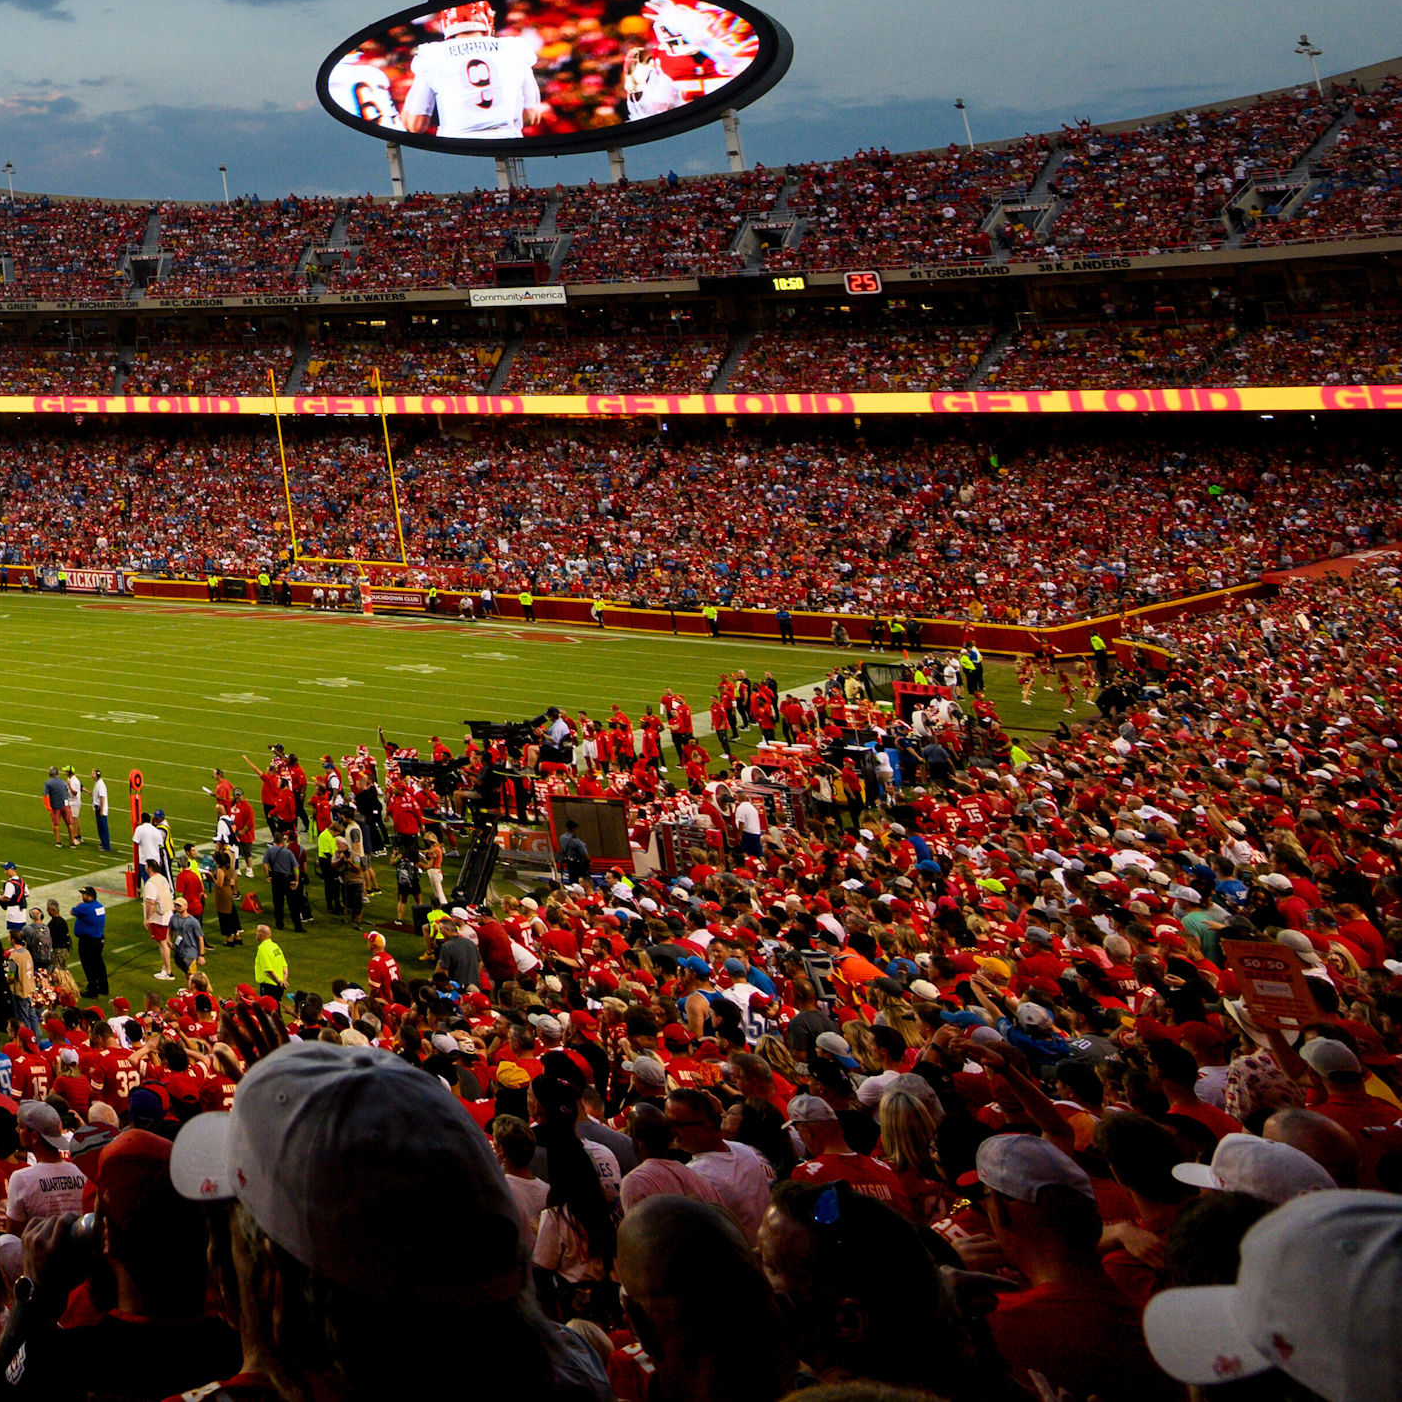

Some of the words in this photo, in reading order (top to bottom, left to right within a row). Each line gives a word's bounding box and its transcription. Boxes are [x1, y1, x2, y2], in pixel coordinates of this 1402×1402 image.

[466, 59, 491, 109] 9
[910, 270, 923, 279] 61
[925, 269, 935, 278] T.
[937, 265, 1010, 278] GRUNHARD
[1038, 263, 1053, 272] 38
[1055, 262, 1069, 271] K.
[1072, 258, 1132, 271] ANDERS
[772, 276, 805, 291] 10:50
[850, 274, 877, 291] 25
[78, 301, 139, 309] RICHARDSON
[265, 296, 320, 304] GONZALEZ
[362, 293, 406, 302] WATERS
[472, 290, 564, 304] CommunityAmerica
[33, 396, 115, 413] GET
[125, 396, 240, 413] LOUD
[293, 396, 379, 413] GET
[395, 396, 525, 414] LOUD
[586, 394, 690, 414] GET
[701, 394, 856, 414] LOUD
[930, 391, 1053, 413] GET
[1066, 387, 1243, 412] LOUD
[370, 594, 404, 603] OUCHDOWN
[404, 595, 420, 603] CLUB
[965, 808, 983, 824] 15
[31, 1076, 48, 1101] 15
[115, 1070, 141, 1098] 32
[39, 1175, 86, 1193] QUARTERBACK
